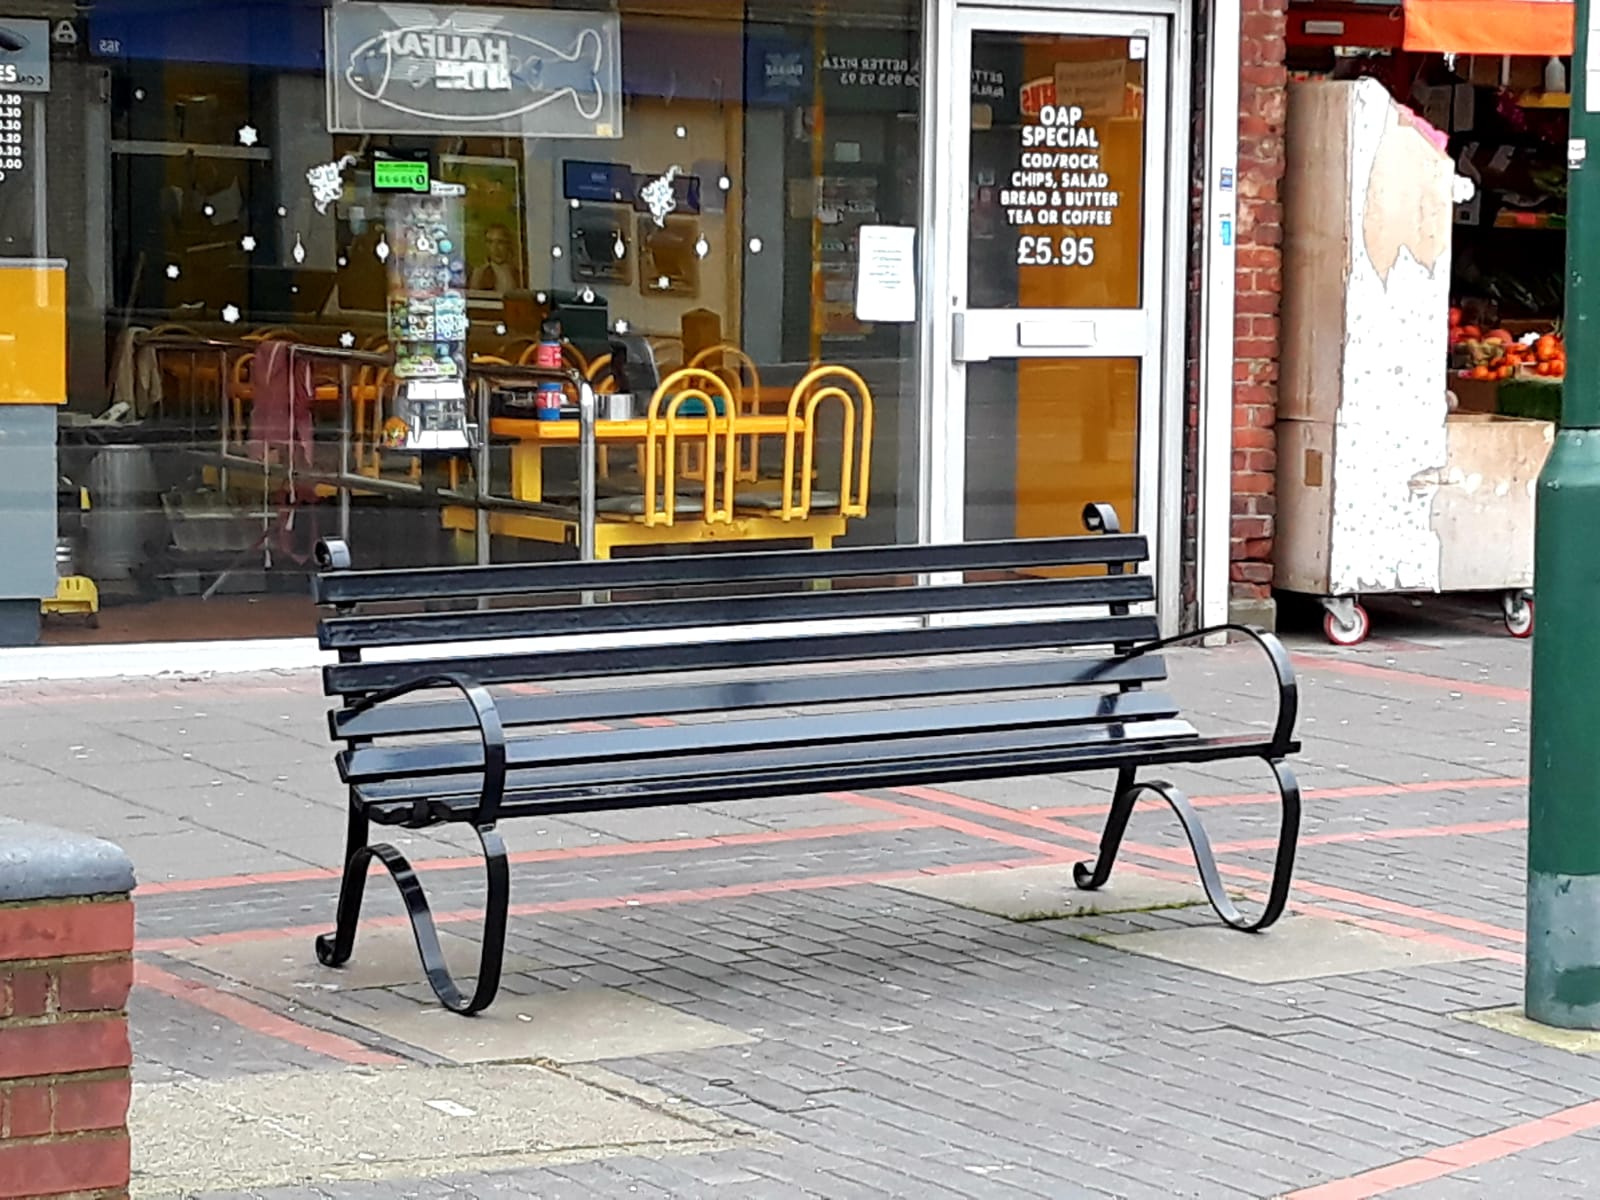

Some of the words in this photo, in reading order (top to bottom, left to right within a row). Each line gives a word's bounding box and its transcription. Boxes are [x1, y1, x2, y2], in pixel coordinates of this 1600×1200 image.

[1040, 105, 1082, 126] OAP
[1022, 125, 1099, 147] SPECIAL
[1022, 153, 1099, 169] COD/ROCK
[1012, 171, 1058, 189] CHIPS,
[1061, 173, 1109, 188] SALAD
[1000, 191, 1047, 206] BREAD
[1051, 192, 1062, 206] &
[1065, 192, 1118, 207] BUTTER
[1007, 209, 1034, 224] TEA
[1037, 210, 1058, 224] OR
[1062, 210, 1112, 225] COFFEE
[1017, 236, 1094, 265] £5.95
